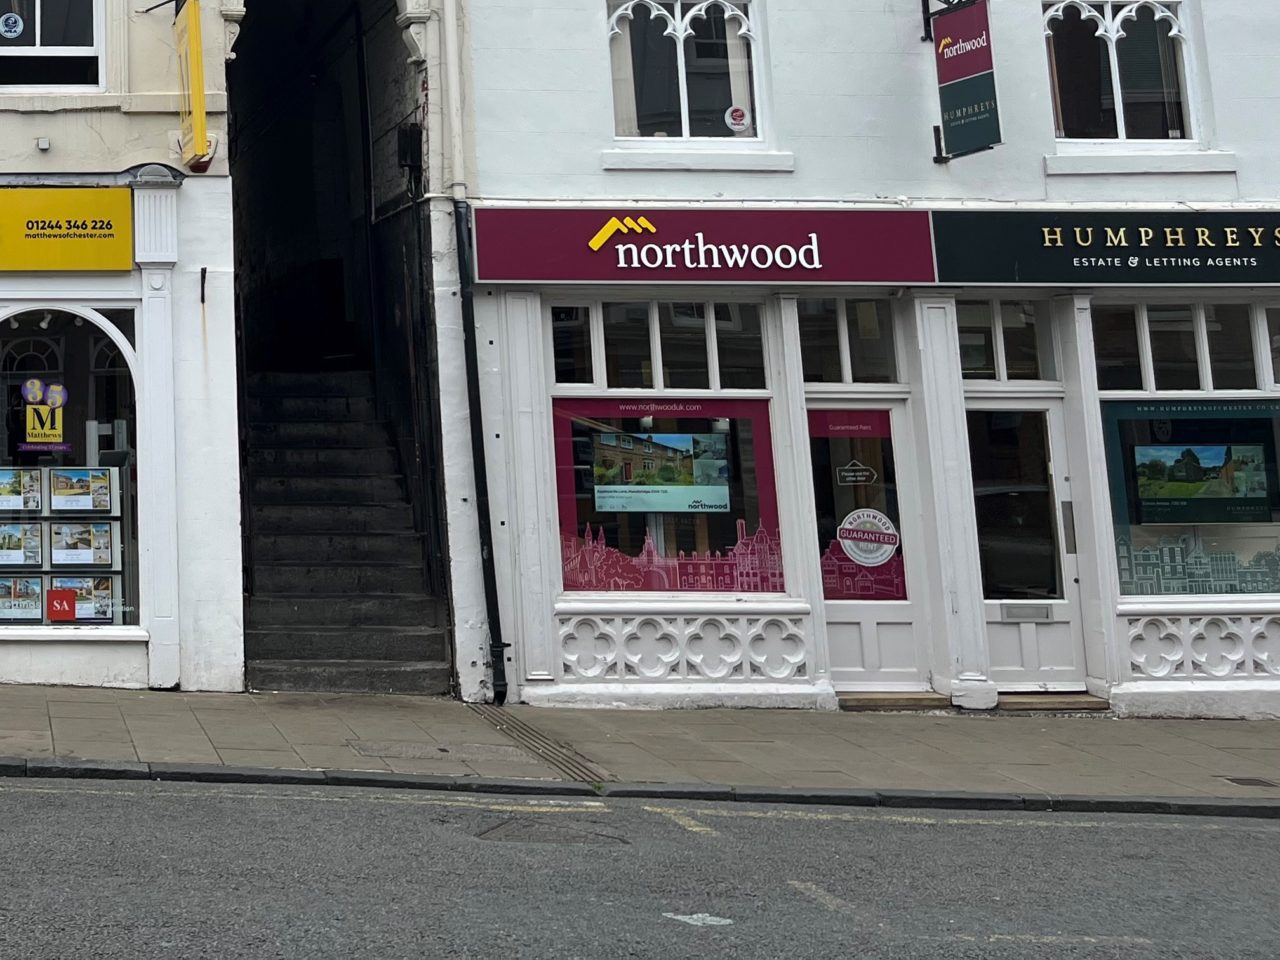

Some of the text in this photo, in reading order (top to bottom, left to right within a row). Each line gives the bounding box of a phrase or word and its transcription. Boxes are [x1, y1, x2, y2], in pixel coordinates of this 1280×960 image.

[943, 31, 988, 59] northwood
[943, 99, 996, 121] HUMPHREYS
[26, 219, 113, 231] 01244 346 226
[24, 230, 115, 240] matthewsofchester.com
[614, 232, 823, 269] northwood
[1072, 256, 1258, 267] ESTATE & LETTING AGENTS
[26, 379, 63, 408] 35
[618, 402, 702, 412] www.northwooduk.com
[30, 406, 58, 431] M
[687, 502, 728, 510] northwood
[847, 512, 891, 531] NORTHWOOD
[840, 529, 896, 543] GUARANTEED
[859, 542, 878, 551] RENT
[52, 599, 70, 611] SA
